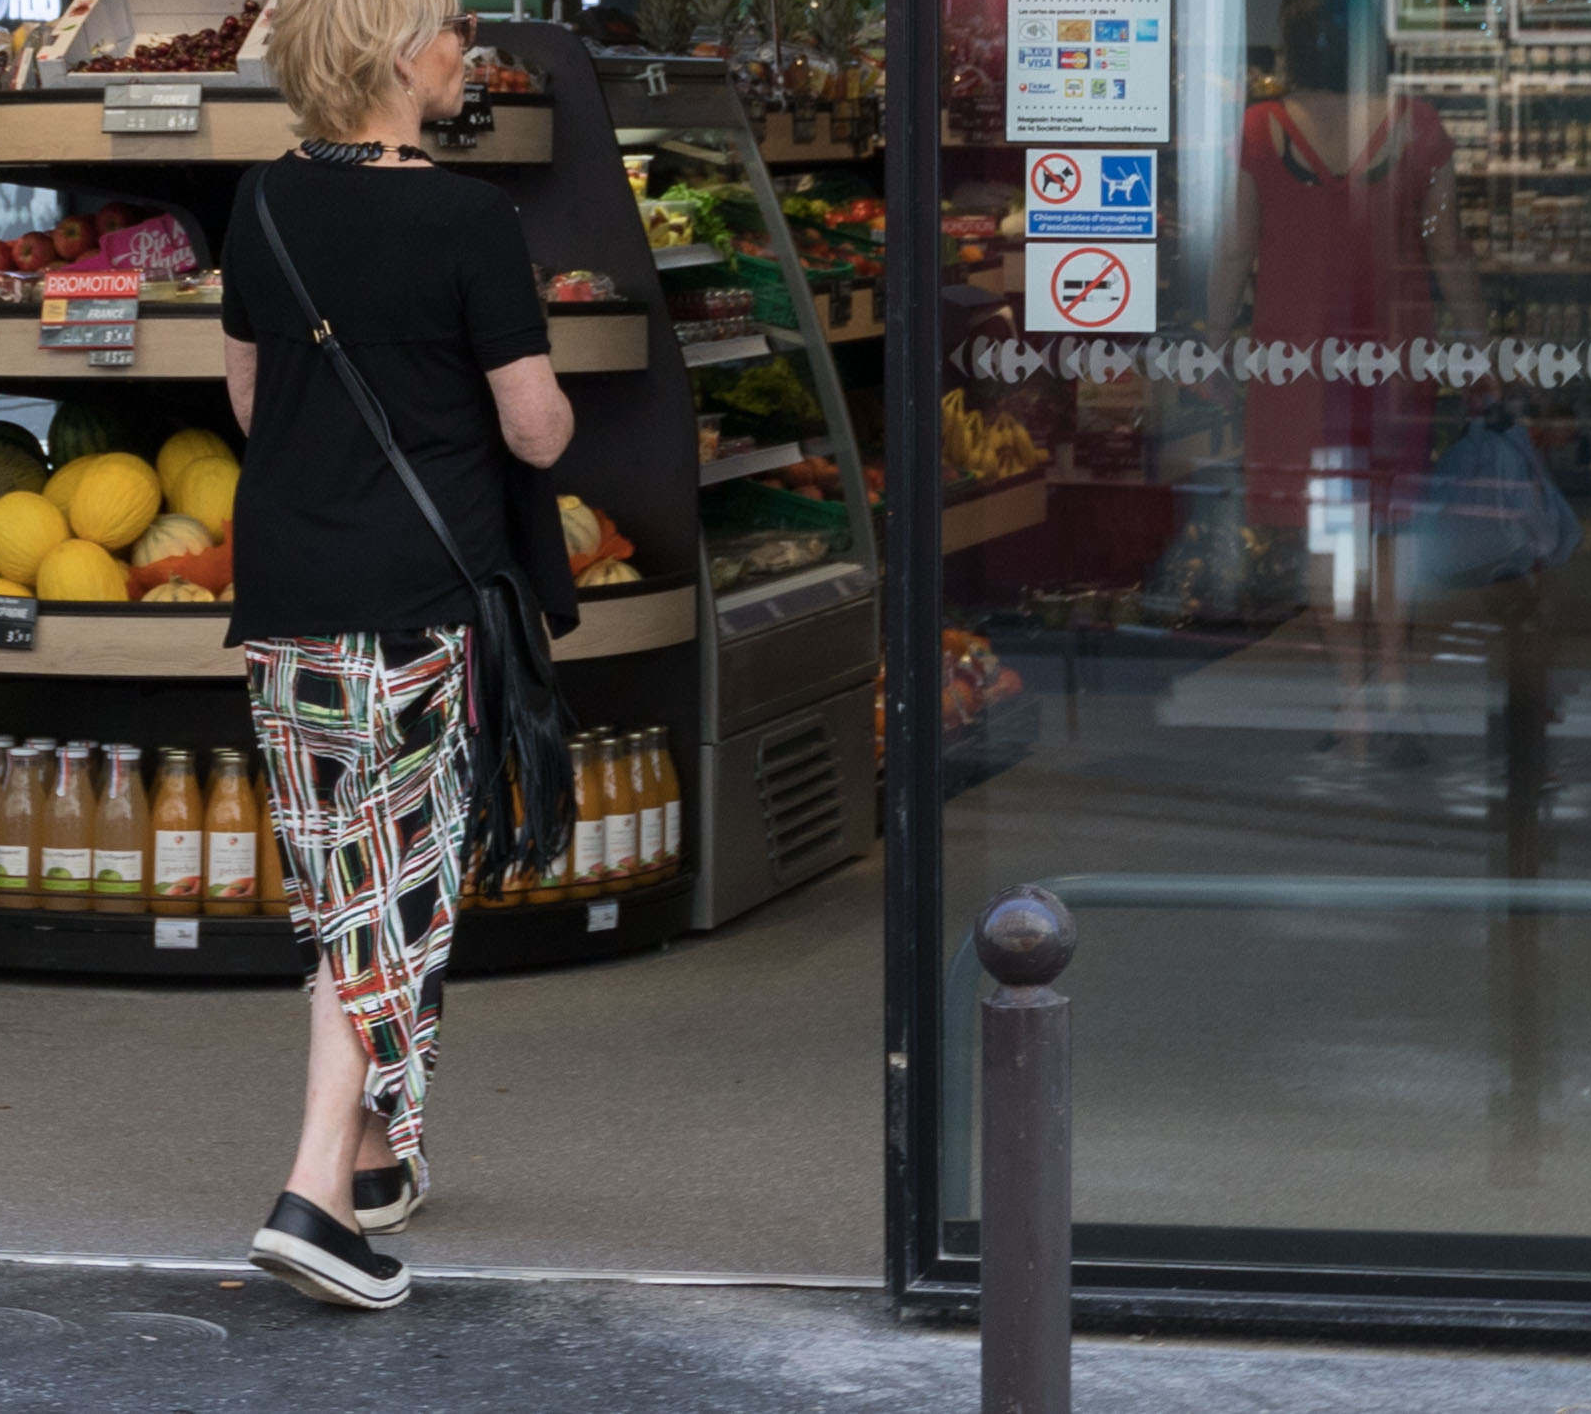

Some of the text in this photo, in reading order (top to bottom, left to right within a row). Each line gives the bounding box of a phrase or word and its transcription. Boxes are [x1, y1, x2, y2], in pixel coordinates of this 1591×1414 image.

[1028, 58, 1052, 68] VISA
[1018, 116, 1048, 124] Magasin
[1033, 213, 1149, 224] Chiens guides d'aveugles ou
[1038, 223, 1143, 233] d'assistance uniquement
[47, 275, 138, 292] PROMOTION
[87, 308, 126, 319] FRANCE
